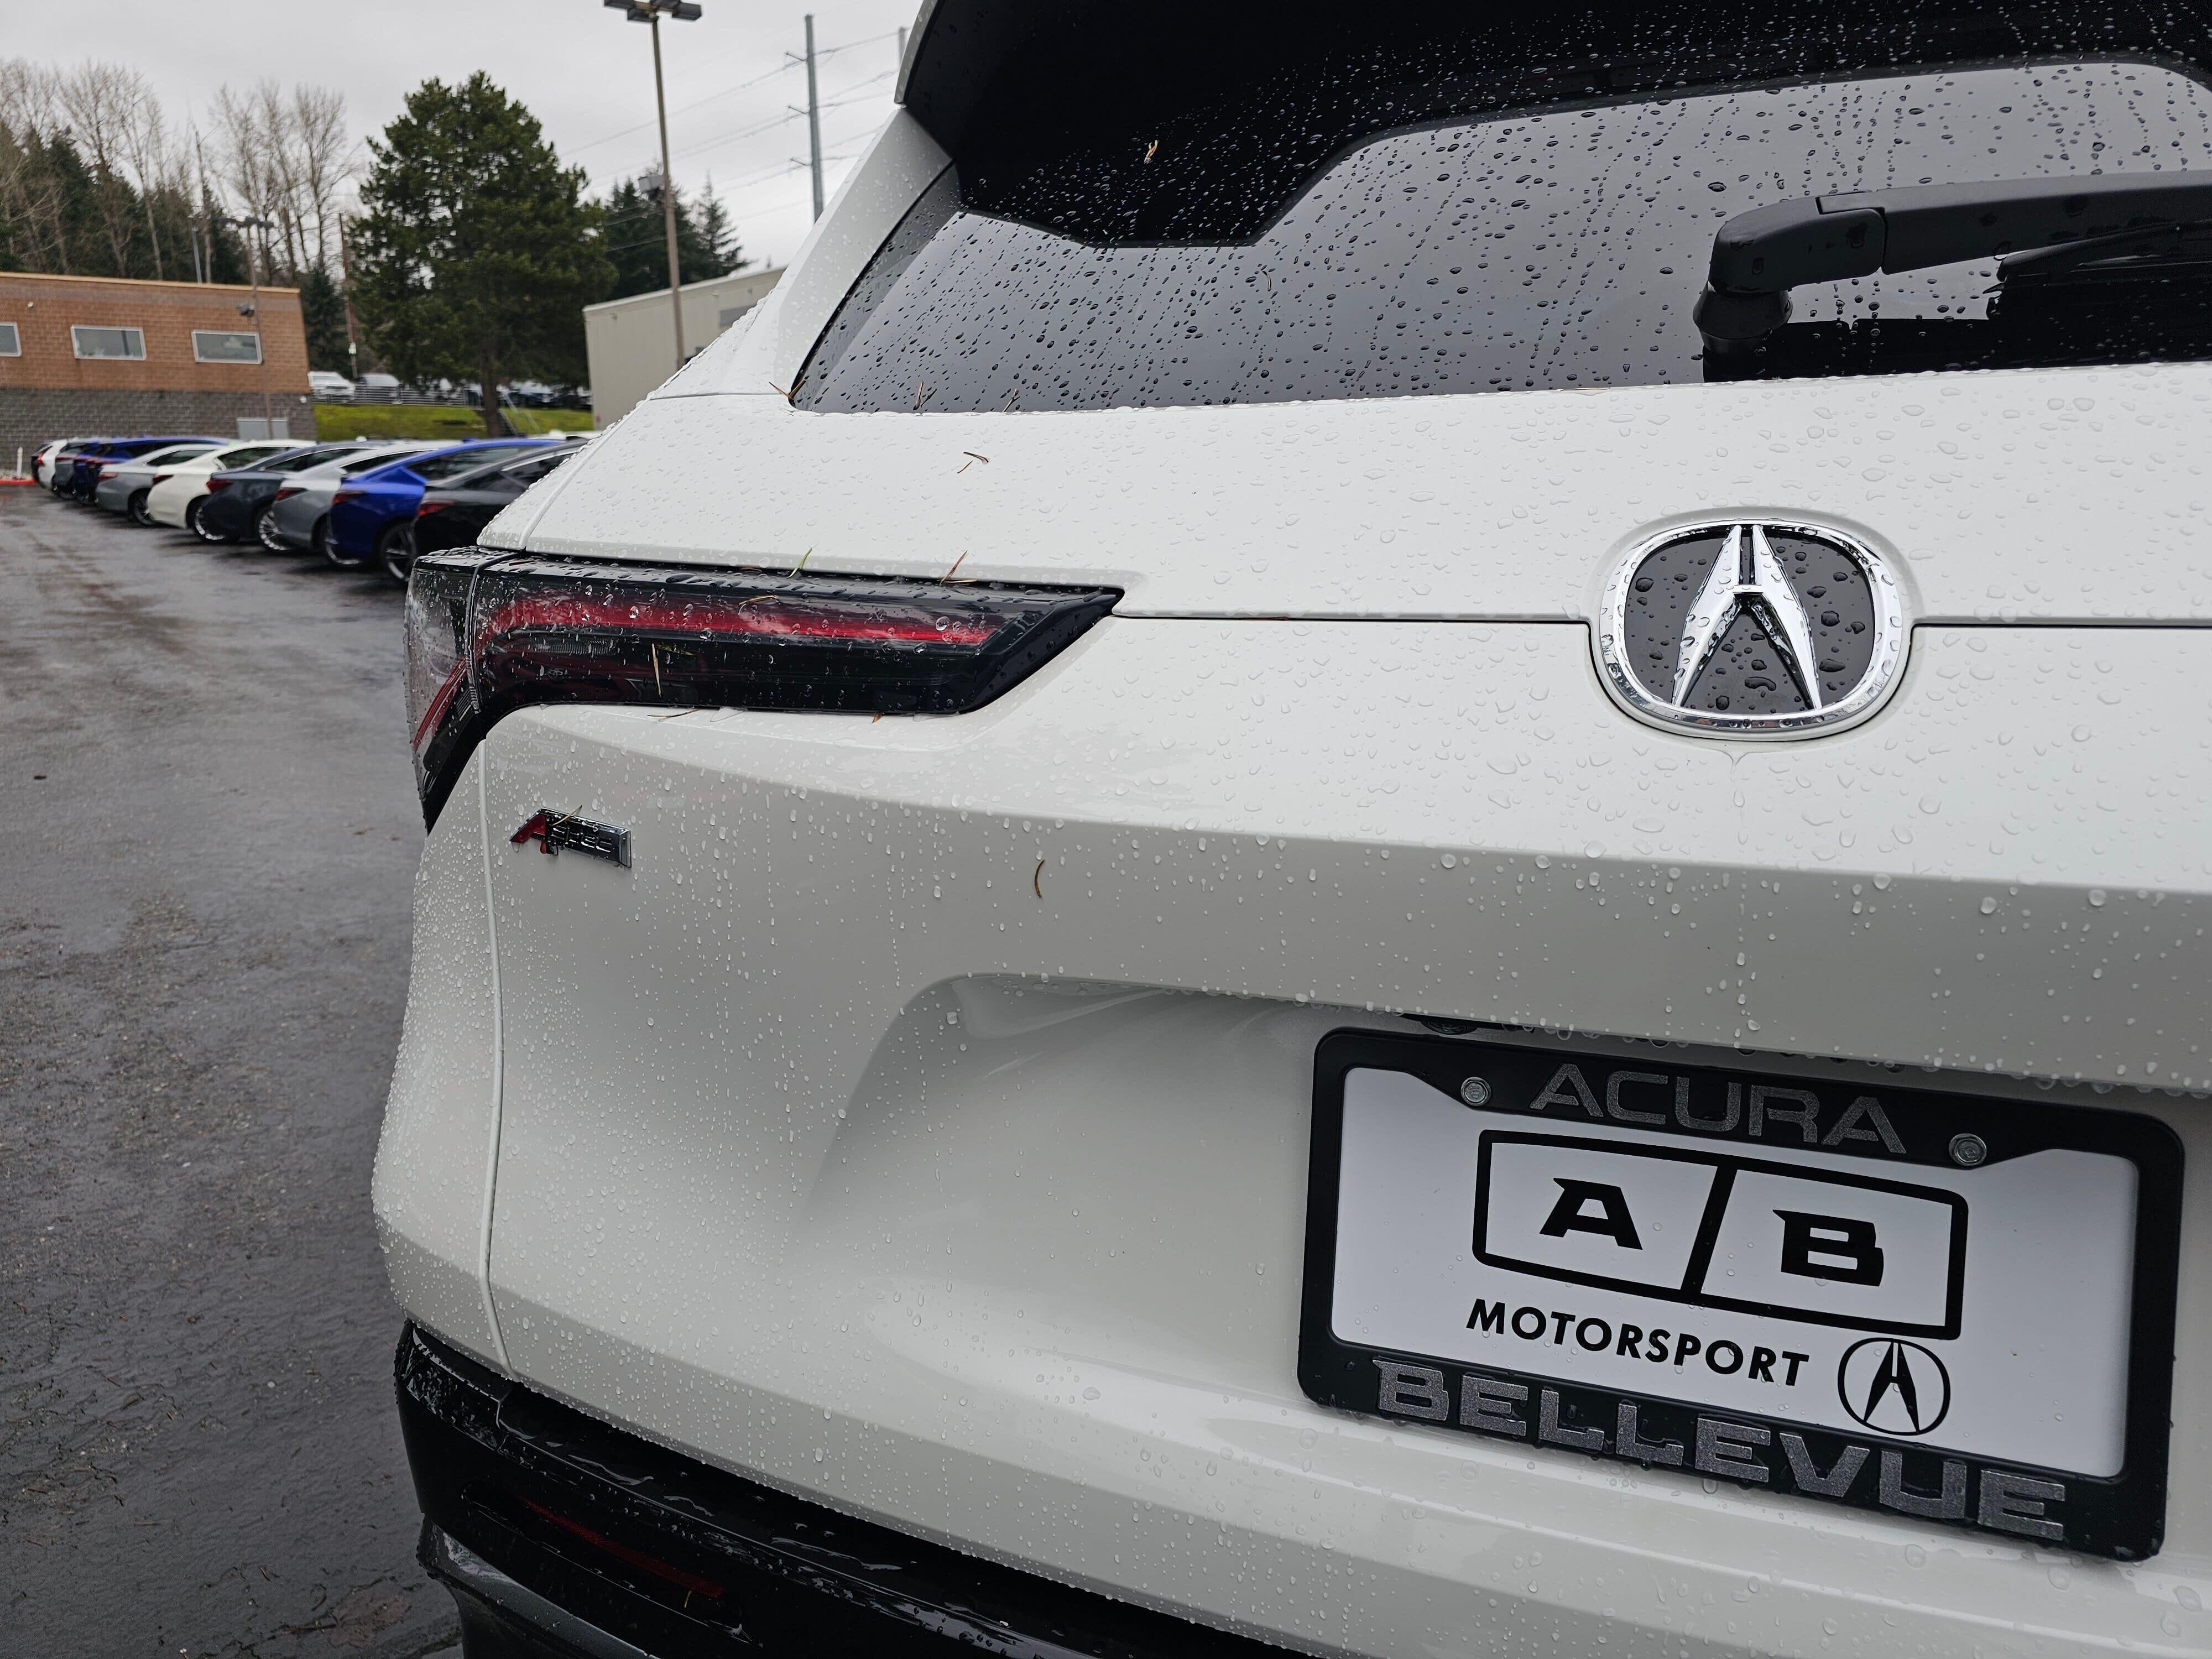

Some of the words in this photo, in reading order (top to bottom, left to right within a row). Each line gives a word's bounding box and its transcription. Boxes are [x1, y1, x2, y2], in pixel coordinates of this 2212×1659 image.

[1529, 1063, 1907, 1154] ACURA
[1539, 1177, 1643, 1250] A
[1772, 1209, 1884, 1287] B
[1465, 1298, 1809, 1387] MOTORSPORT
[1372, 1355, 2066, 1540] BELLEVUE
